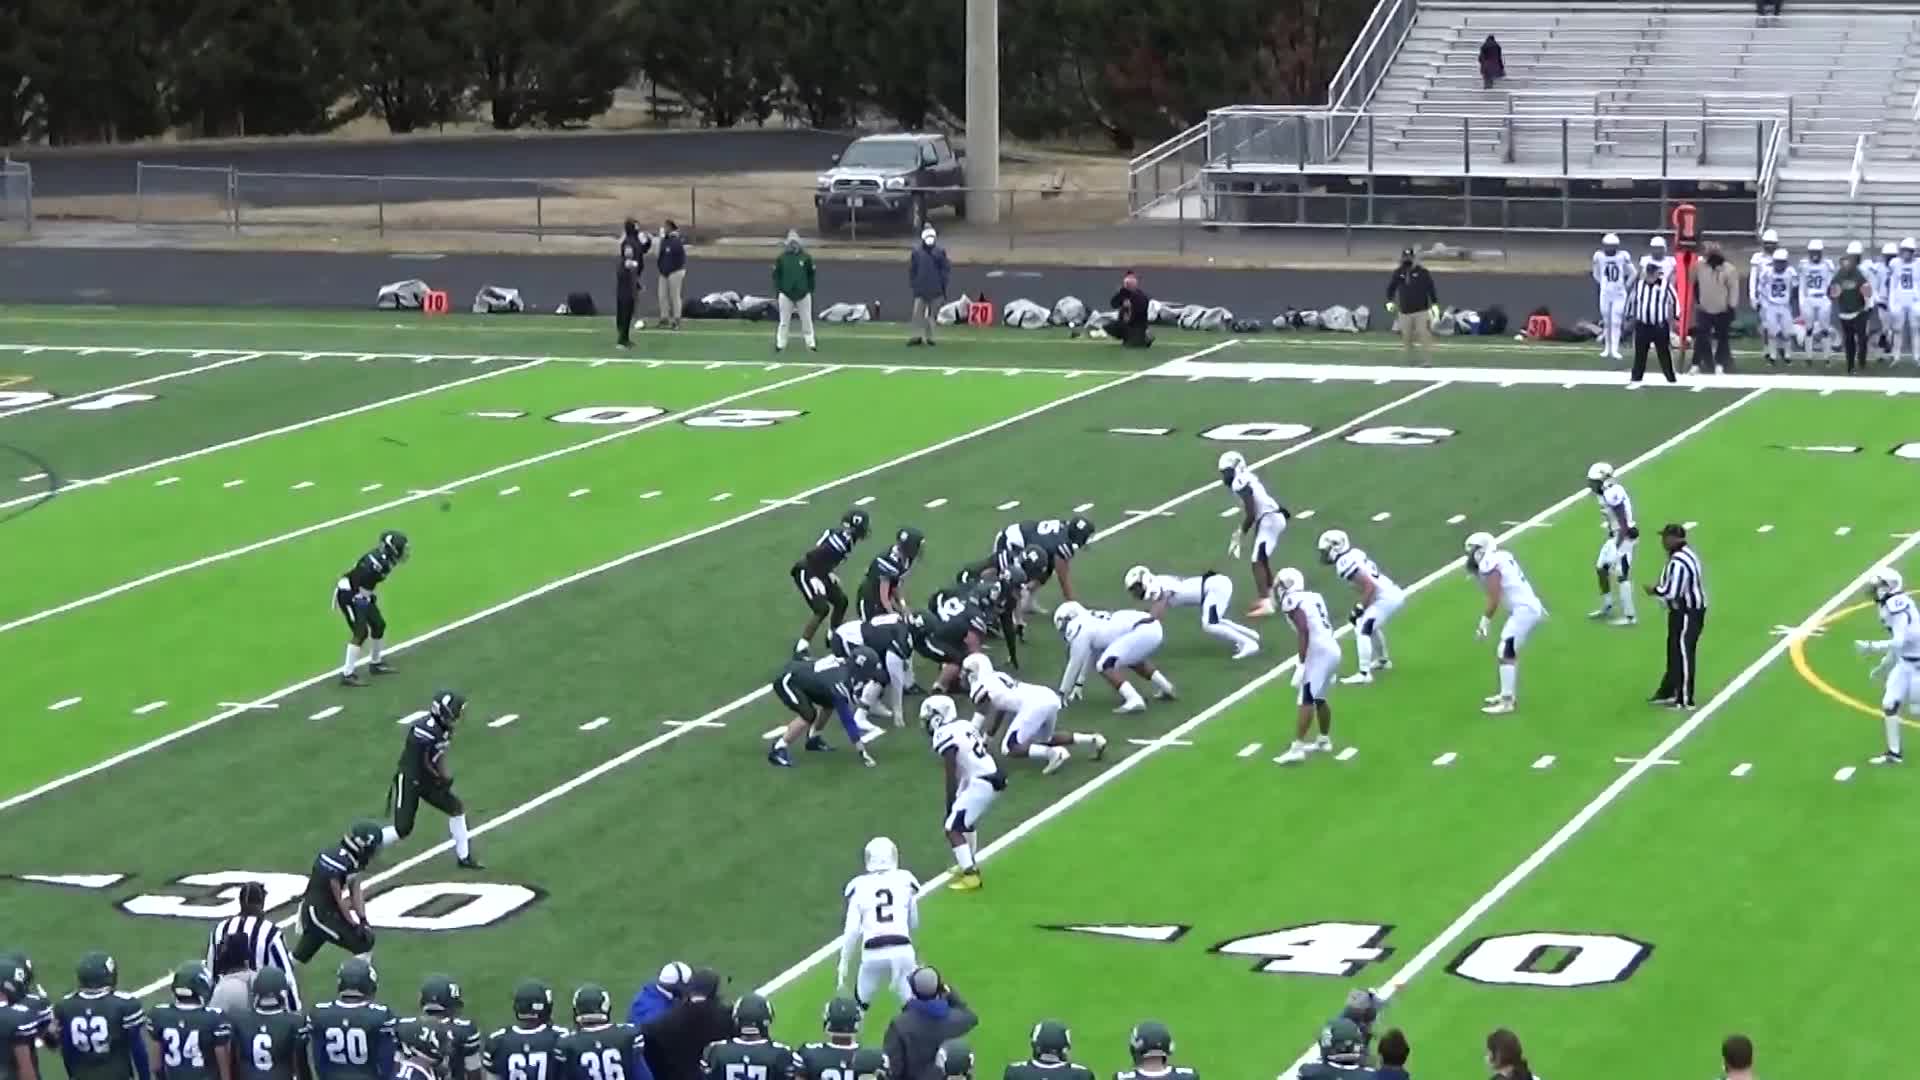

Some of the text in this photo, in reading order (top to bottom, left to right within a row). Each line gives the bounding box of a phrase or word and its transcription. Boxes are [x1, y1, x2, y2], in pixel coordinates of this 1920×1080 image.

[1604, 264, 1619, 282] 40
[428, 294, 444, 311] 10
[970, 305, 989, 322] 20
[874, 888, 894, 923] 2
[1214, 920, 1649, 987] 40
[71, 1015, 110, 1053] 62
[162, 1028, 205, 1067] 34
[252, 1032, 273, 1071] 6
[325, 1026, 368, 1065] 20
[508, 1052, 548, 1080] 67
[580, 1048, 625, 1080] 36
